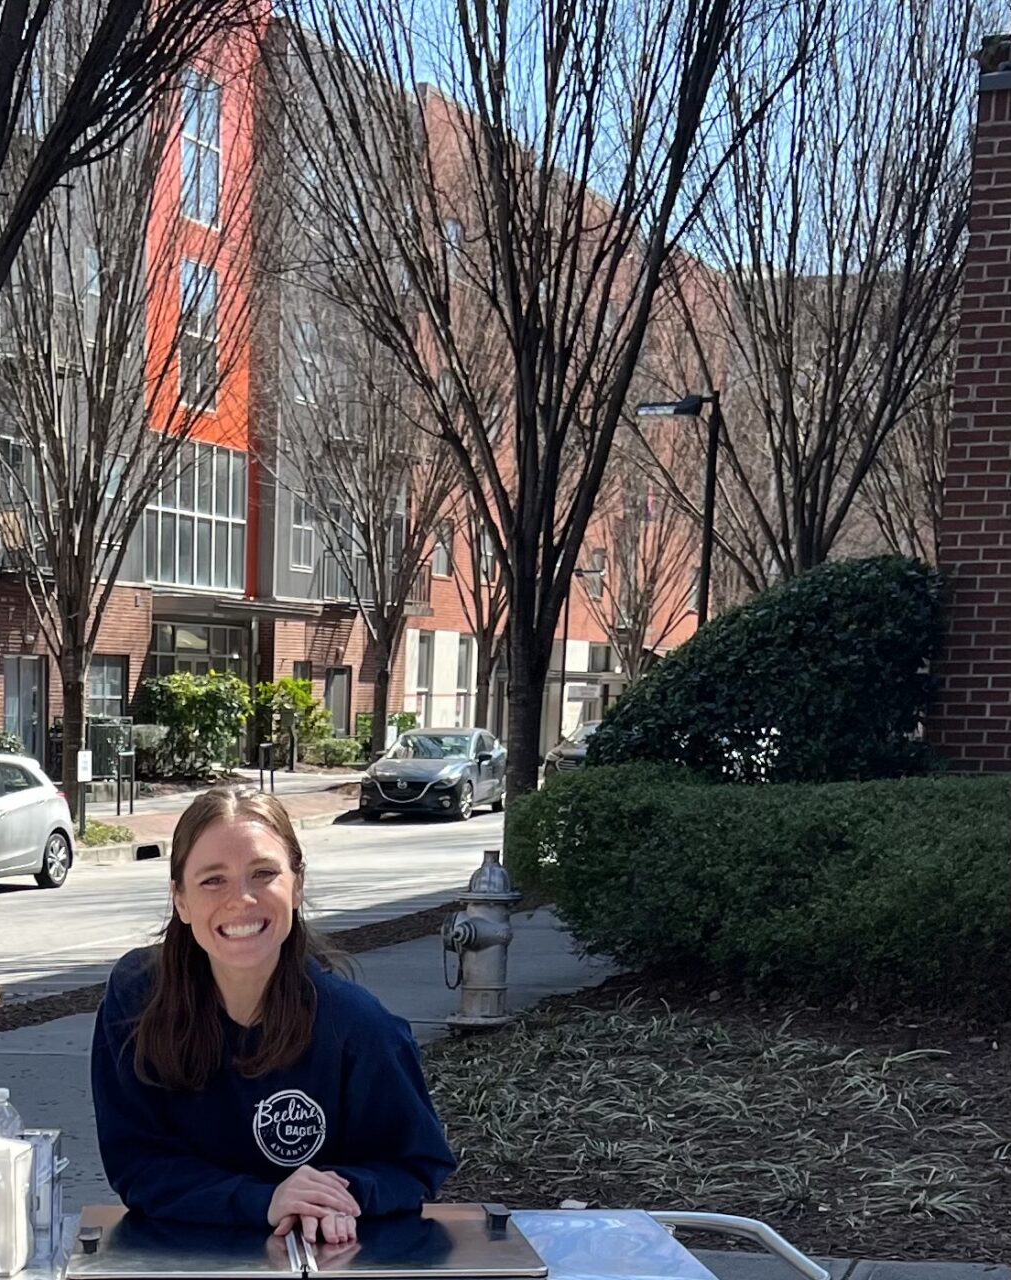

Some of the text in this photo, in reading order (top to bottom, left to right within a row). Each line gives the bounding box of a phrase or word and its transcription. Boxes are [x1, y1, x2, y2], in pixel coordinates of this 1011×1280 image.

[254, 1098, 319, 1129] Beeline
[285, 1123, 327, 1137] BAGELS
[270, 1142, 309, 1156] ATLANTA
